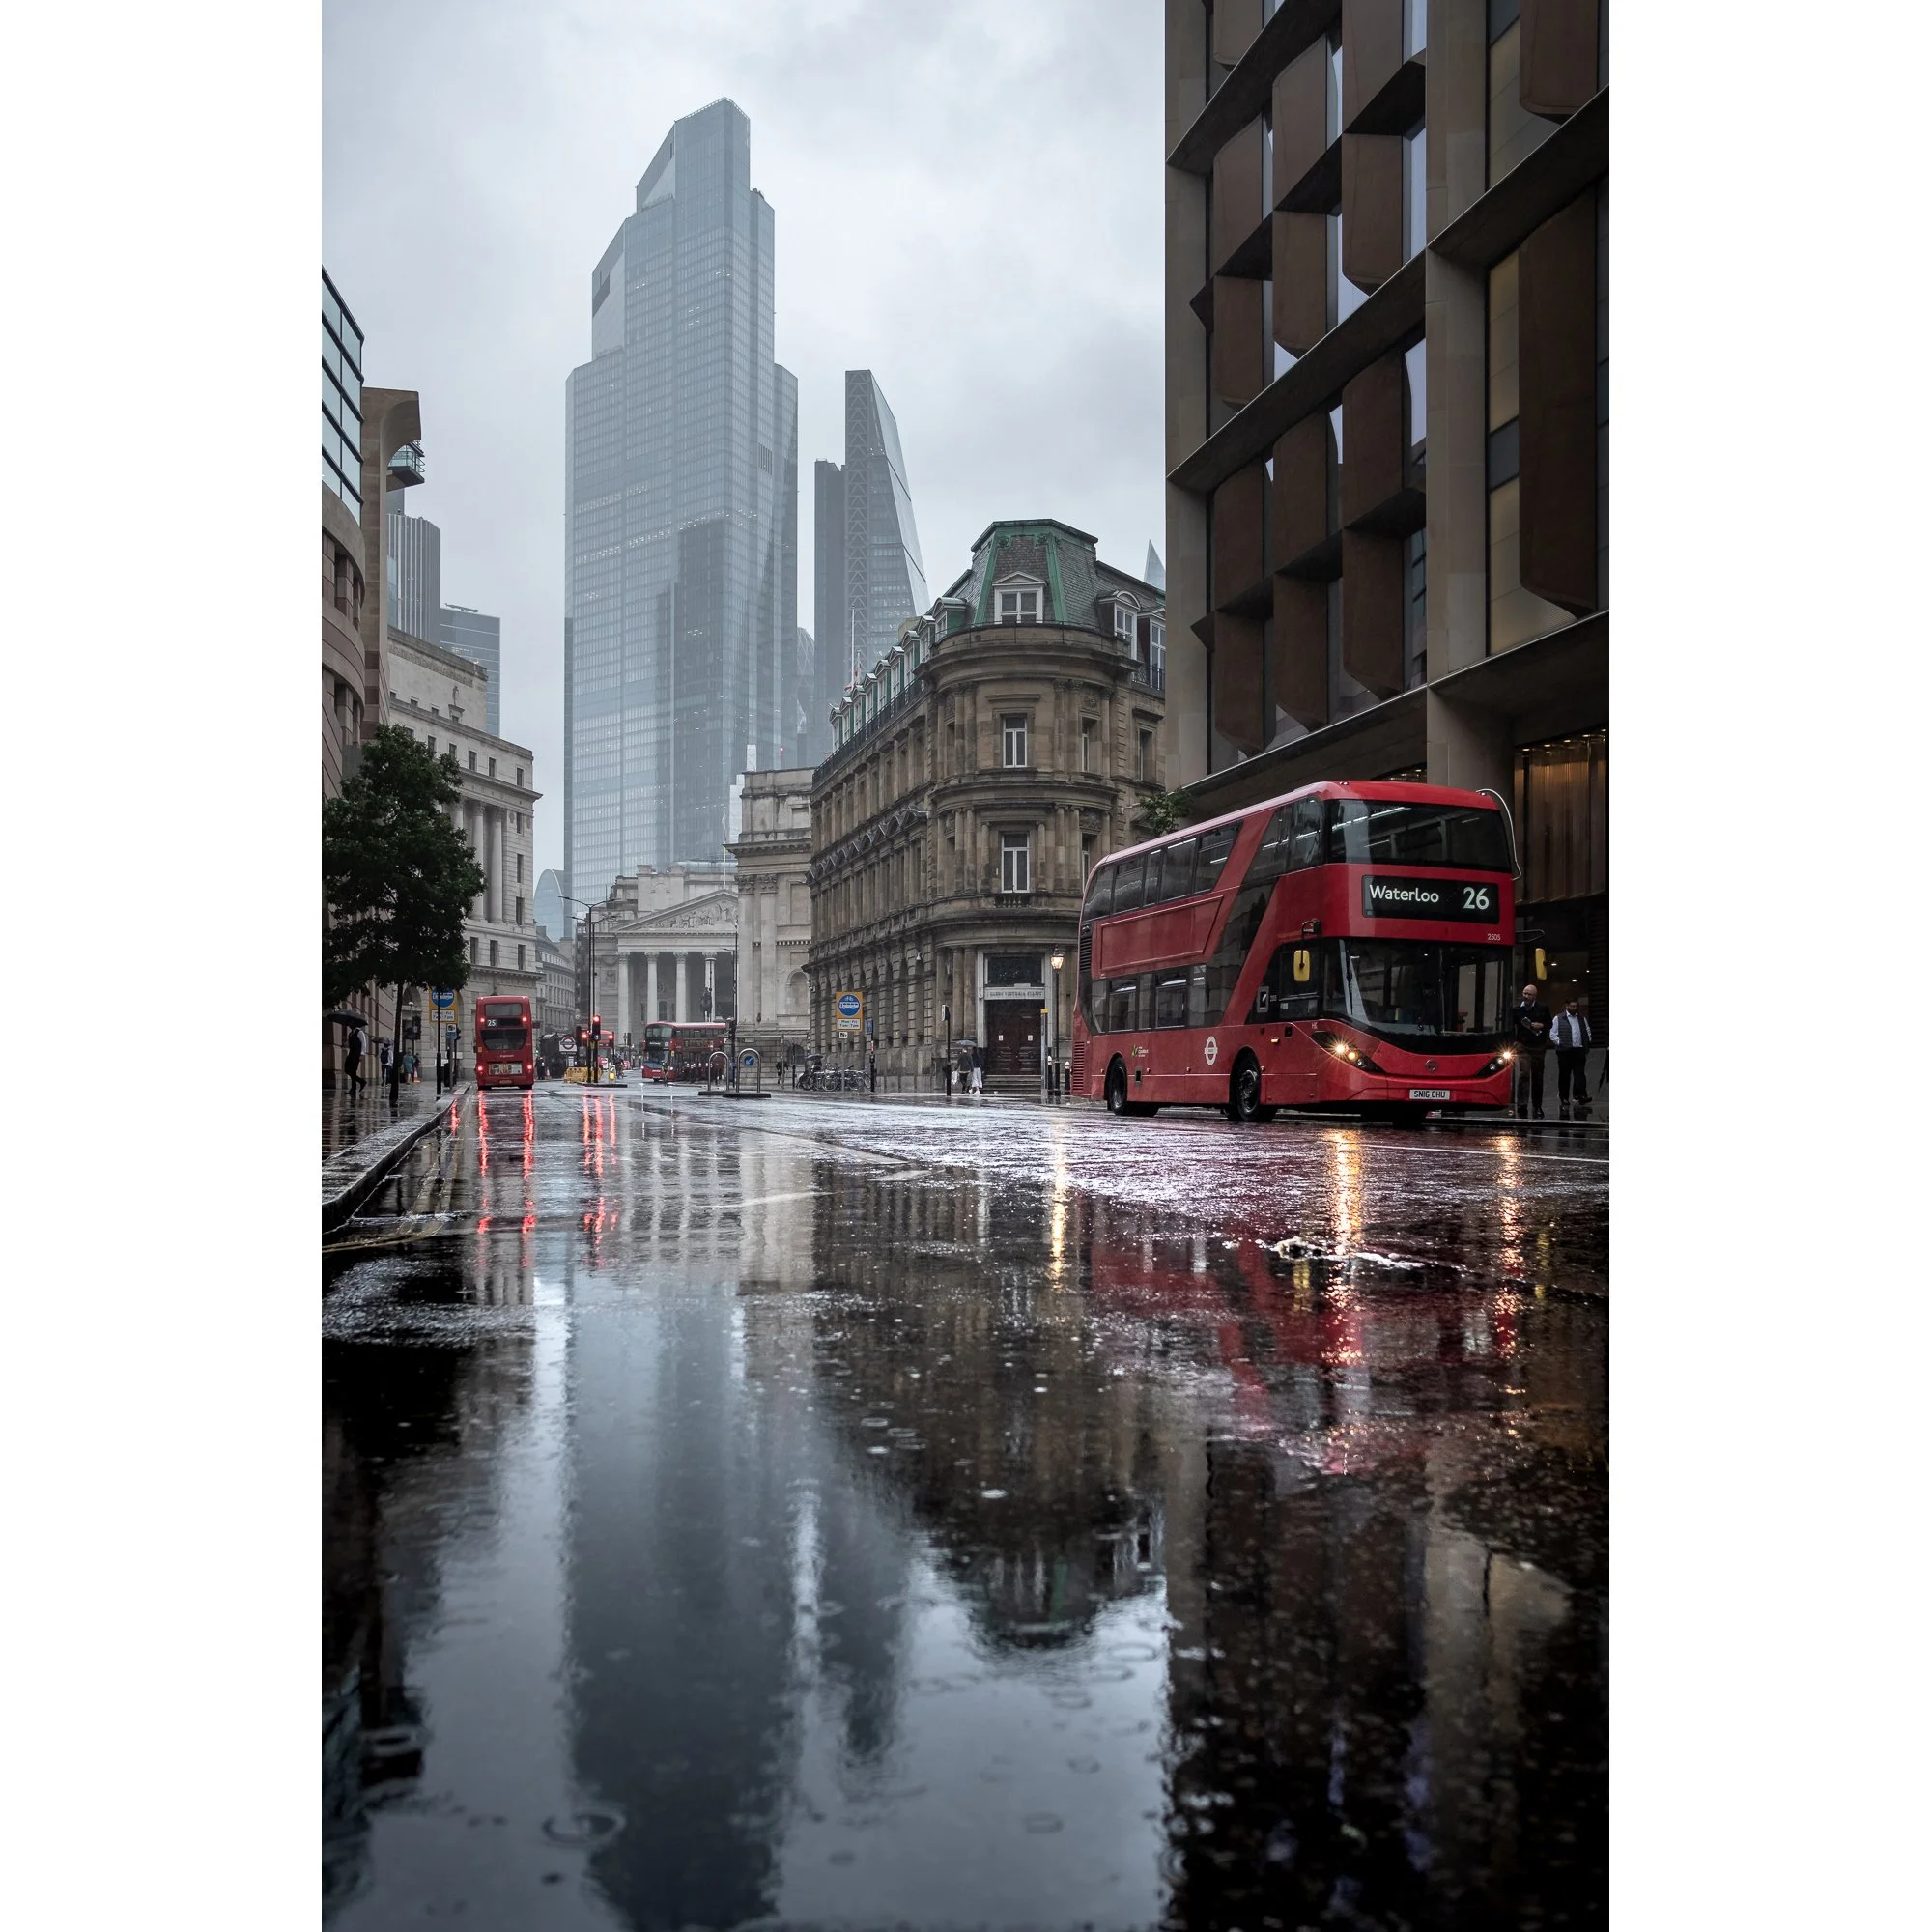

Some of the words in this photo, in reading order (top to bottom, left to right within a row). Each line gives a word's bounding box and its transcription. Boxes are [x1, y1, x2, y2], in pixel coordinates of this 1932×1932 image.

[1369, 884, 1439, 903] Waterloo
[1463, 887, 1490, 910] 26
[1413, 1090, 1430, 1098] SN16
[1431, 1090, 1446, 1098] OHU
